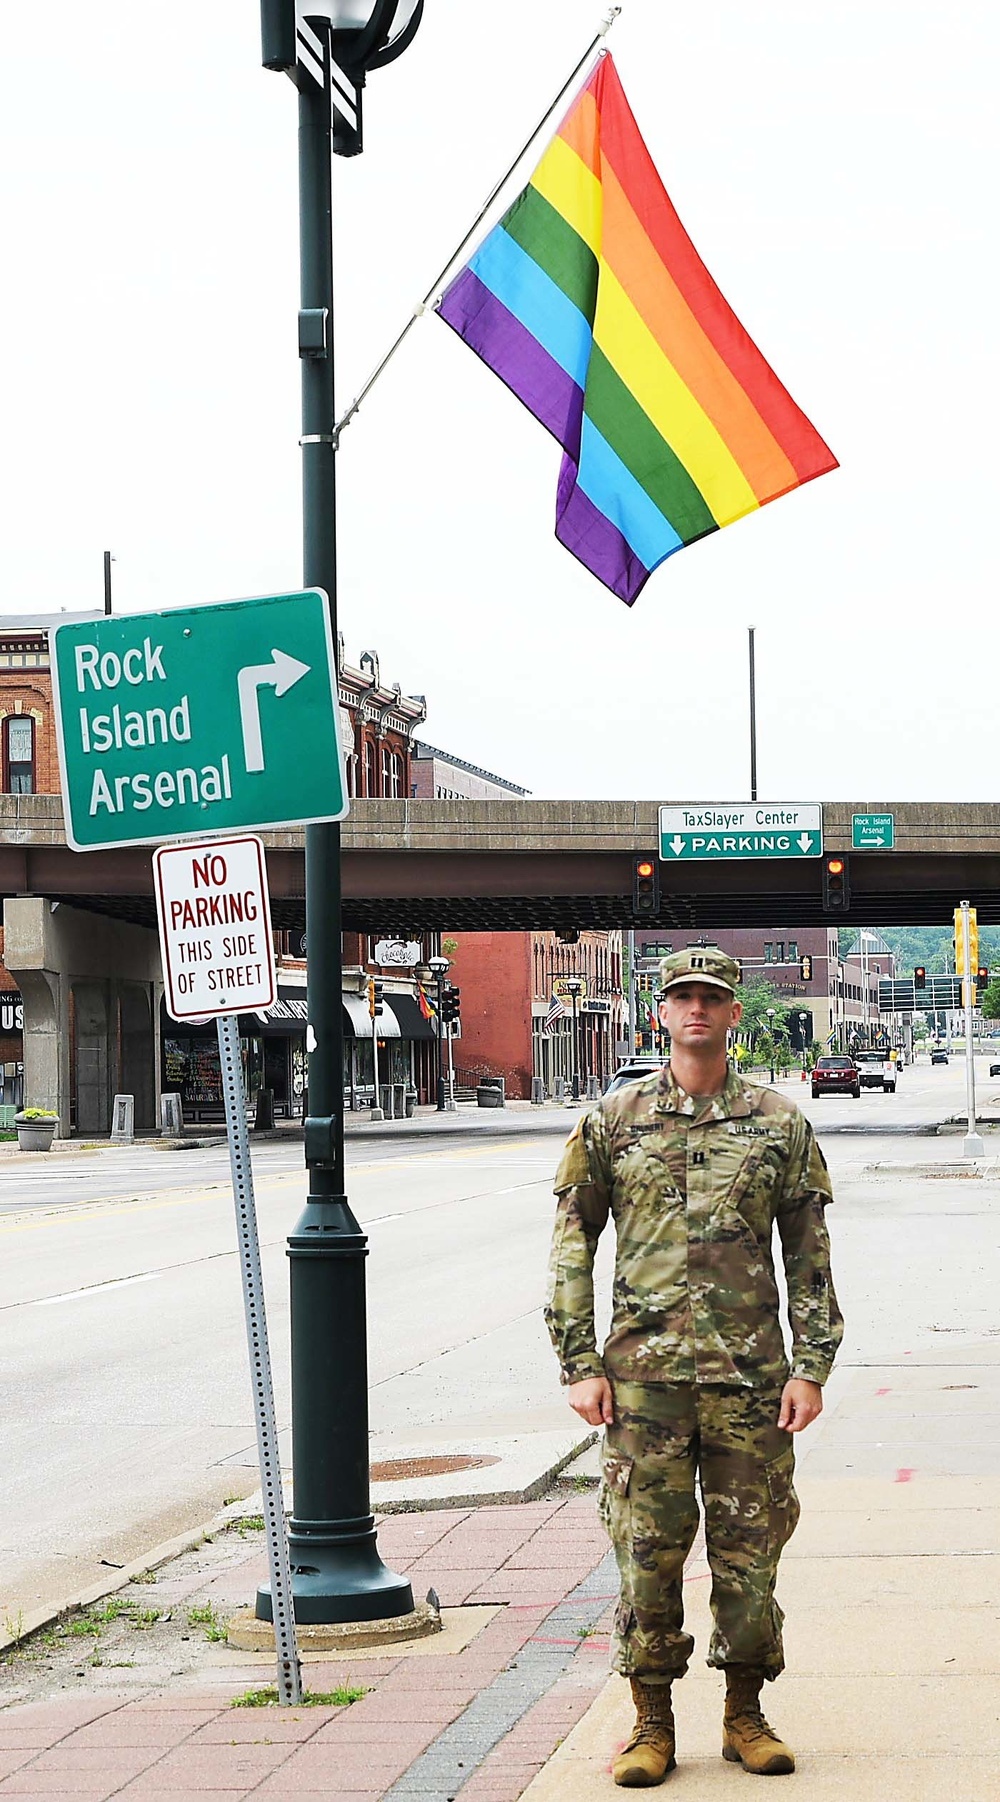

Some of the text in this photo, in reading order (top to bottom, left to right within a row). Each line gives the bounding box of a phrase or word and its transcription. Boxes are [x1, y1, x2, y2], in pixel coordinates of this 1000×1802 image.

[74, 637, 167, 692] Rock
[79, 695, 191, 753] Island
[89, 754, 232, 816] Arsenal
[682, 810, 799, 830] TaxSlayer Center
[854, 817, 891, 826] Rock Island
[861, 826, 885, 835] Arsenal
[692, 836, 790, 852] PARKING
[191, 854, 227, 889] NO
[170, 891, 258, 931] PARKING
[178, 934, 257, 964] THIS SIDE
[177, 963, 262, 995] OF STREET
